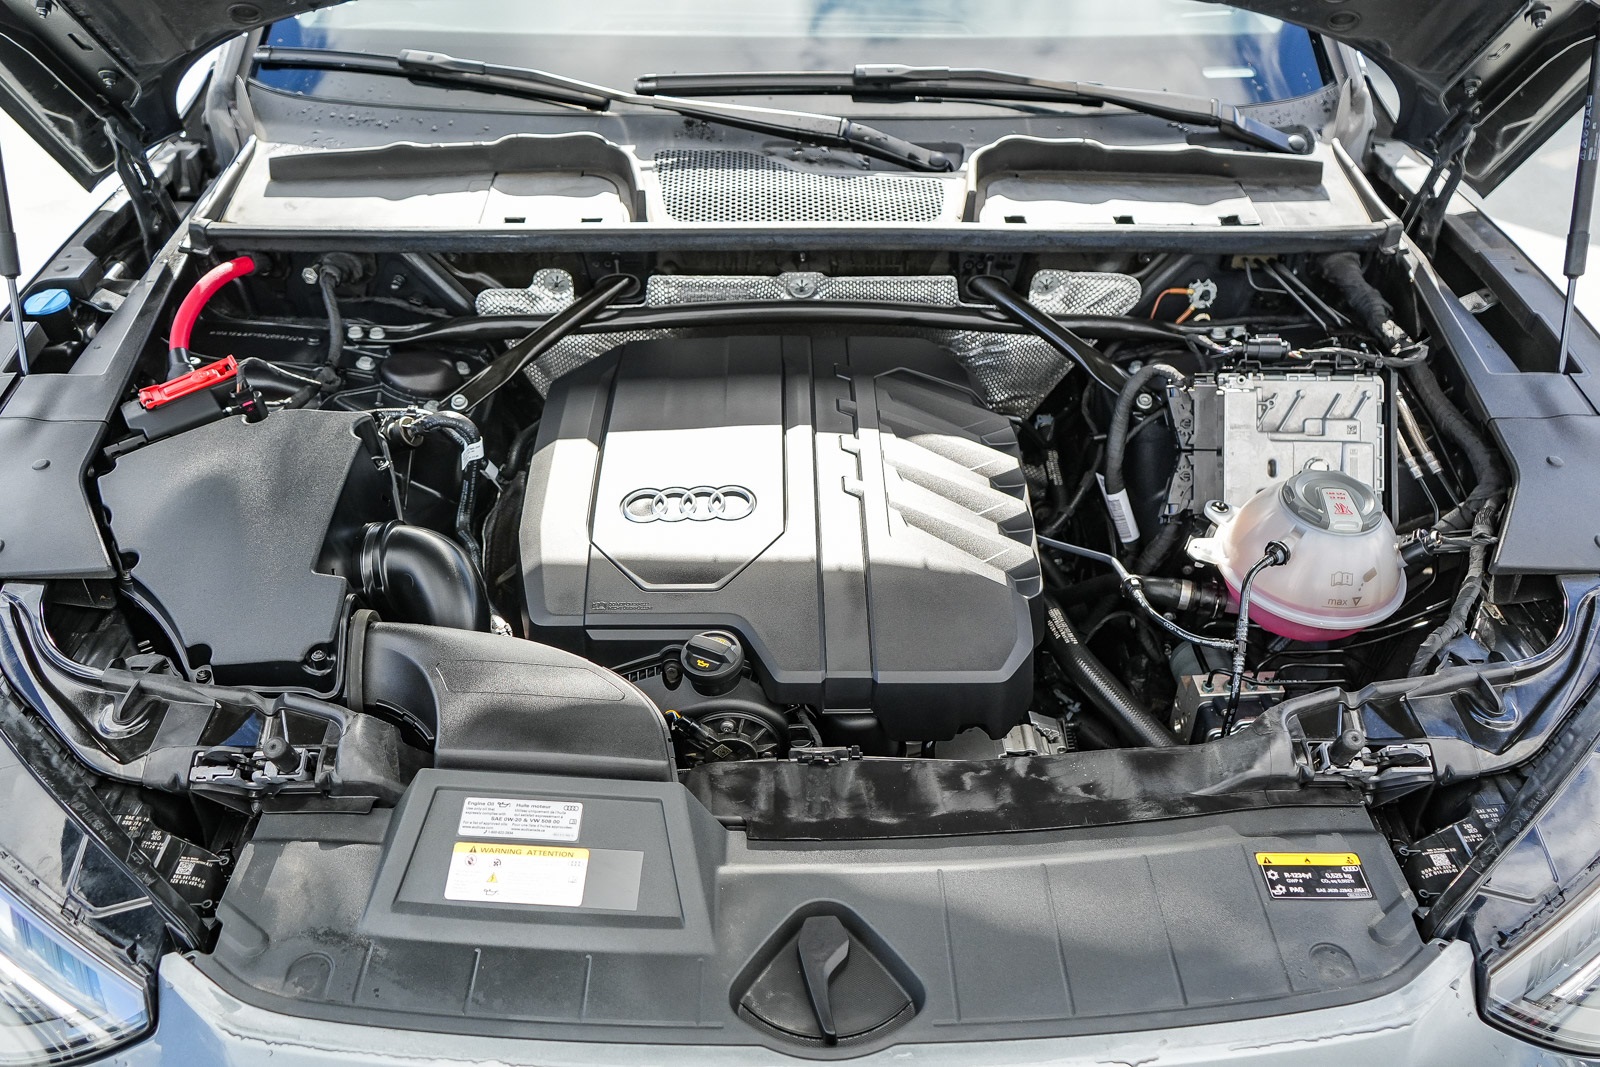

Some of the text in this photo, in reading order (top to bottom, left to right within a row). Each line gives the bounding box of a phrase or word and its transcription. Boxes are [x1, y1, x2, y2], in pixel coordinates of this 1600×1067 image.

[1327, 597, 1348, 606] max
[480, 847, 575, 858] WARNING ATTENTION
[1283, 872, 1312, 880] R-1234yf
[1343, 872, 1353, 880] kg
